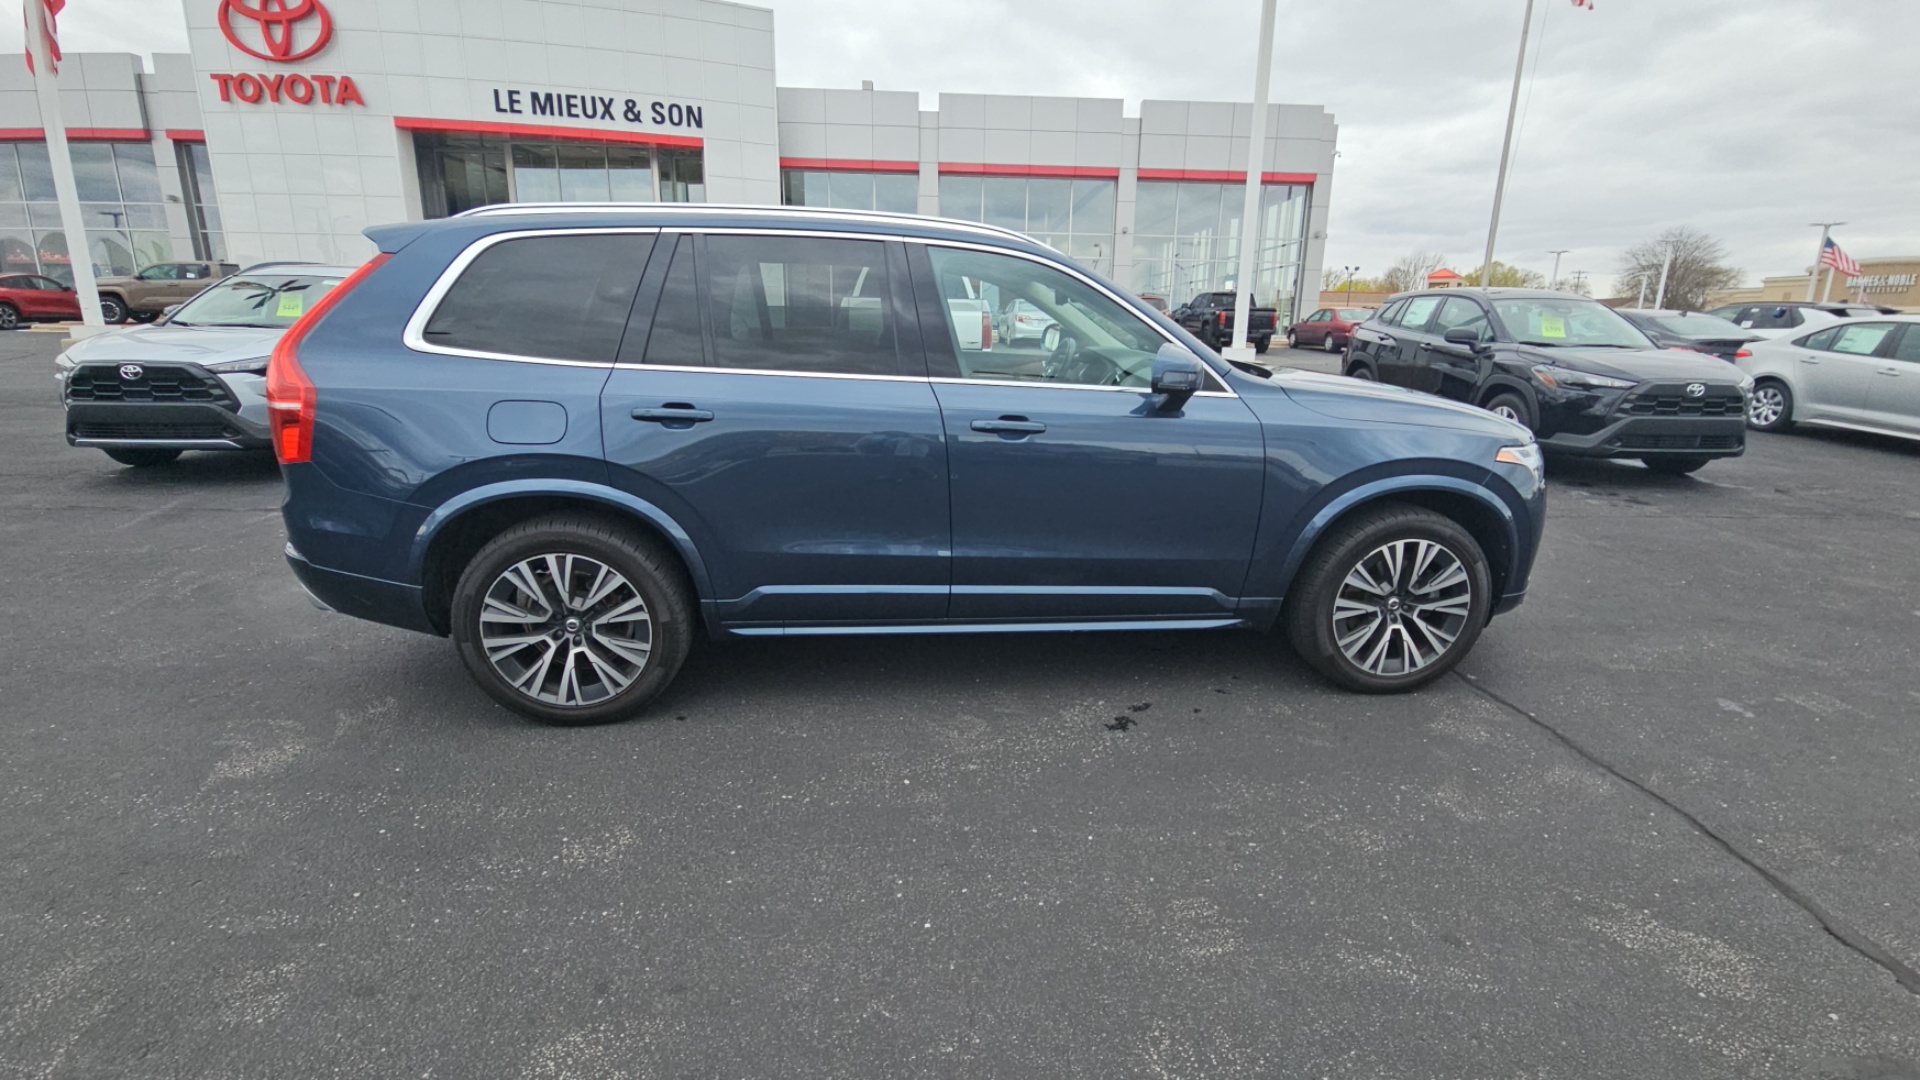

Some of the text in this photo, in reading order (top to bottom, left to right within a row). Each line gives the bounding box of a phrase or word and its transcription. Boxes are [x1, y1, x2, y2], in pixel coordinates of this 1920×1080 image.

[210, 73, 366, 106] TOYOTA
[493, 88, 703, 128] LE MIEUX & SON
